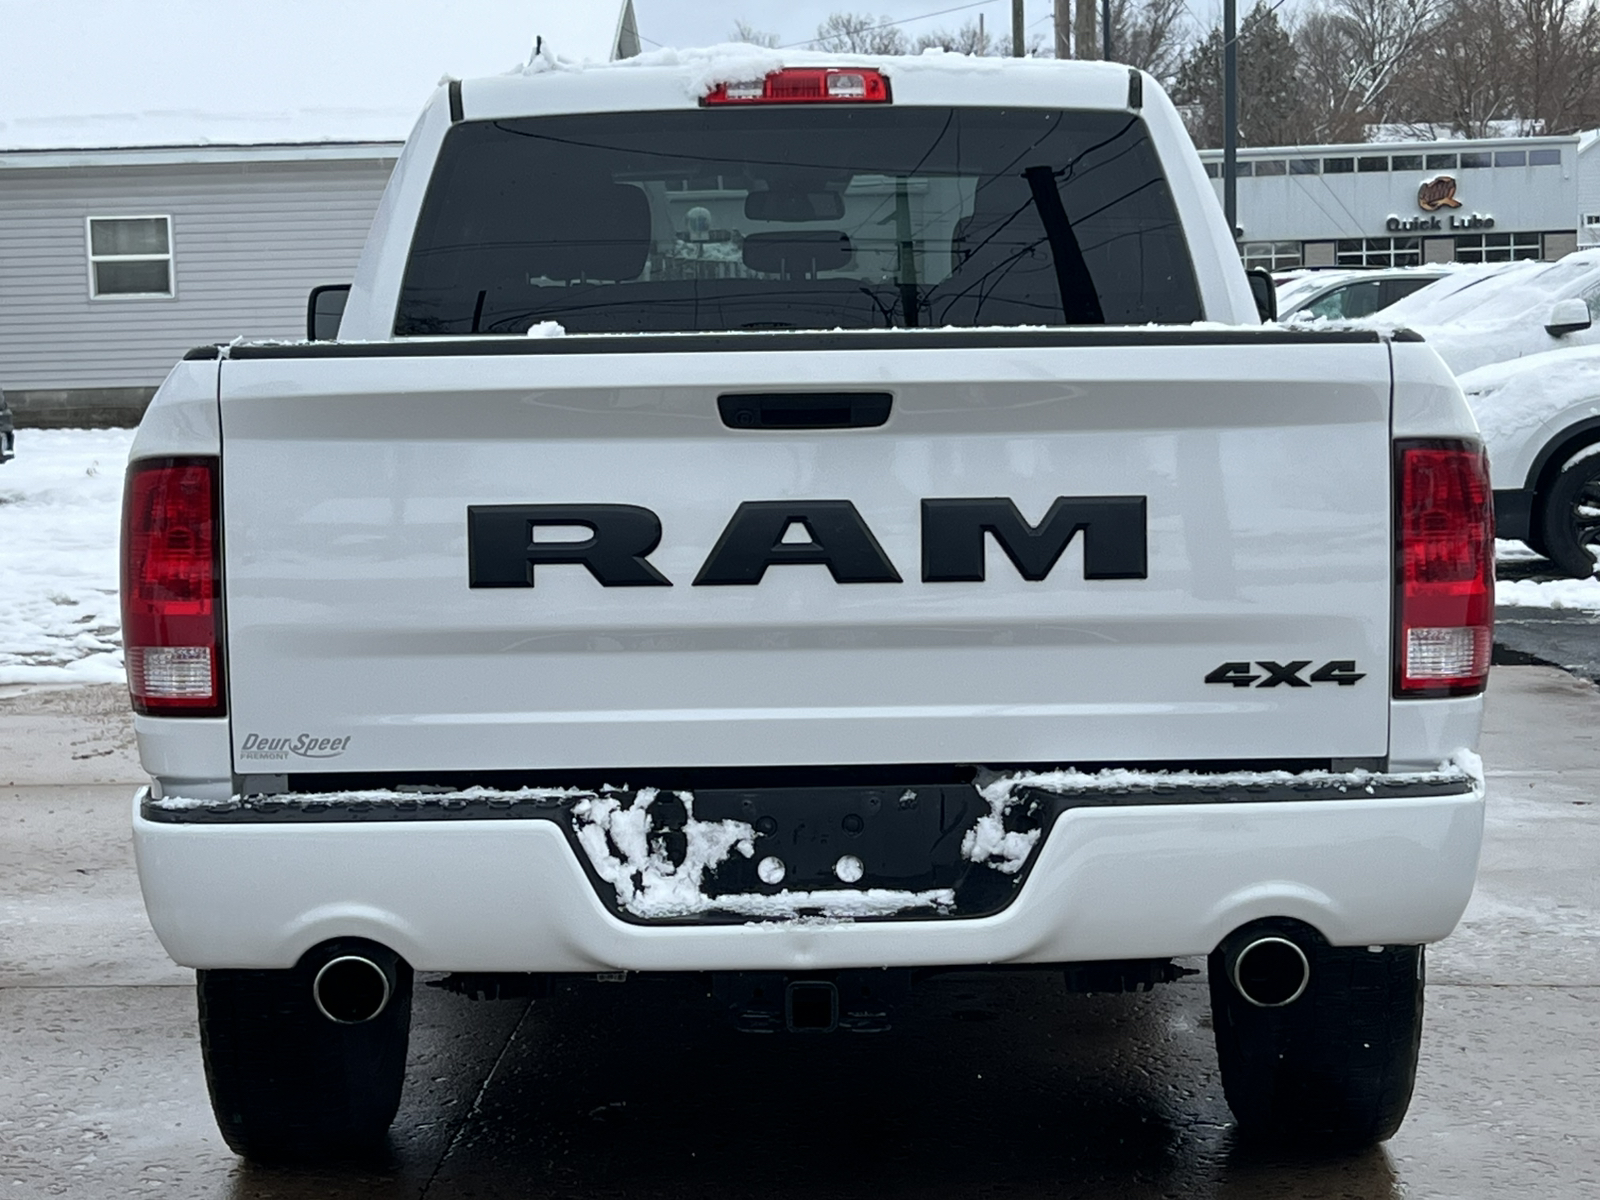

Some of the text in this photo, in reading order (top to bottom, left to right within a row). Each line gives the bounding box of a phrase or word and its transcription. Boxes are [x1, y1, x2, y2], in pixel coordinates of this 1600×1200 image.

[1386, 213, 1495, 232] Quick Lube
[467, 495, 1148, 588] RAM
[240, 751, 289, 760] FREMONT
